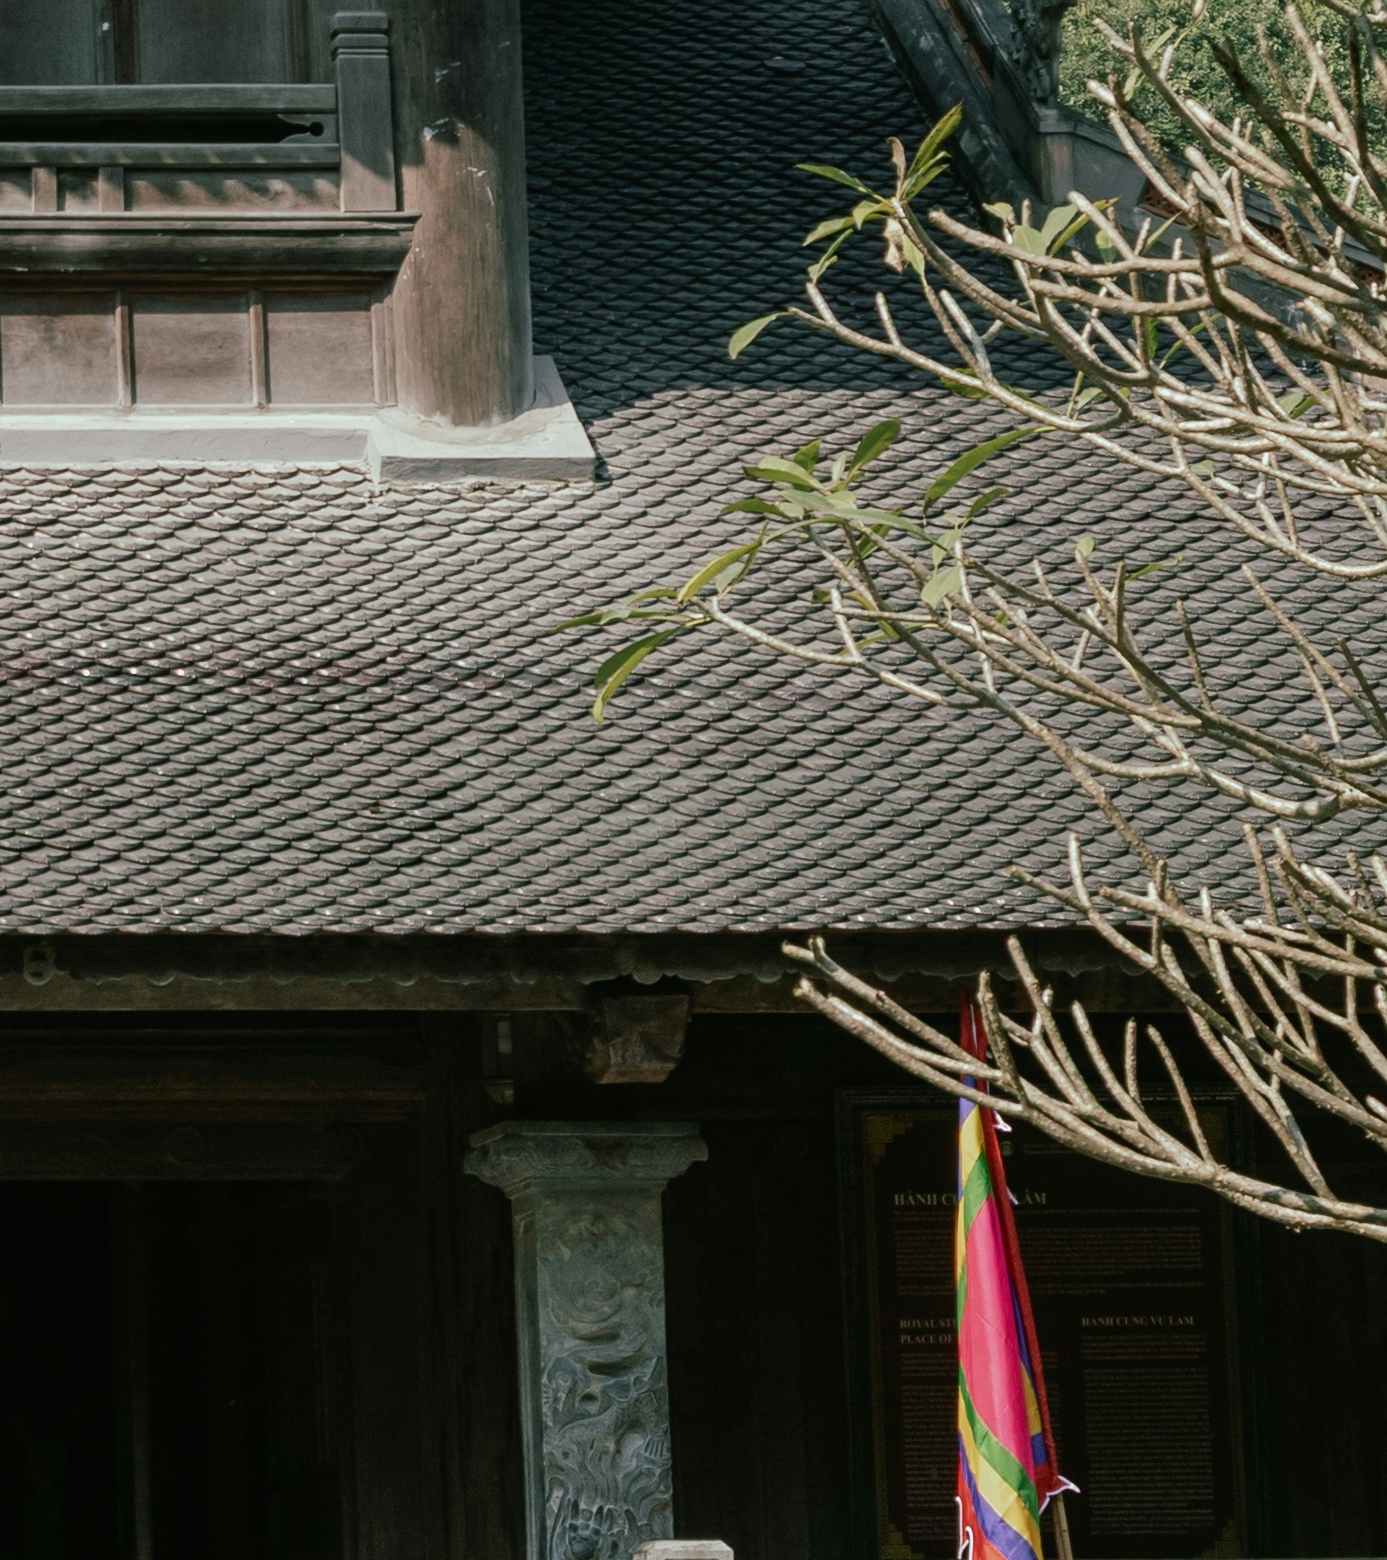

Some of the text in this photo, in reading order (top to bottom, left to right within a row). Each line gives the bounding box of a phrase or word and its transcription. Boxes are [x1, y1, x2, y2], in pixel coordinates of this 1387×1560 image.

[894, 1189, 938, 1206] HÀNH
[899, 1318, 937, 1329] ROYAL
[900, 1333, 937, 1344] PLACE
